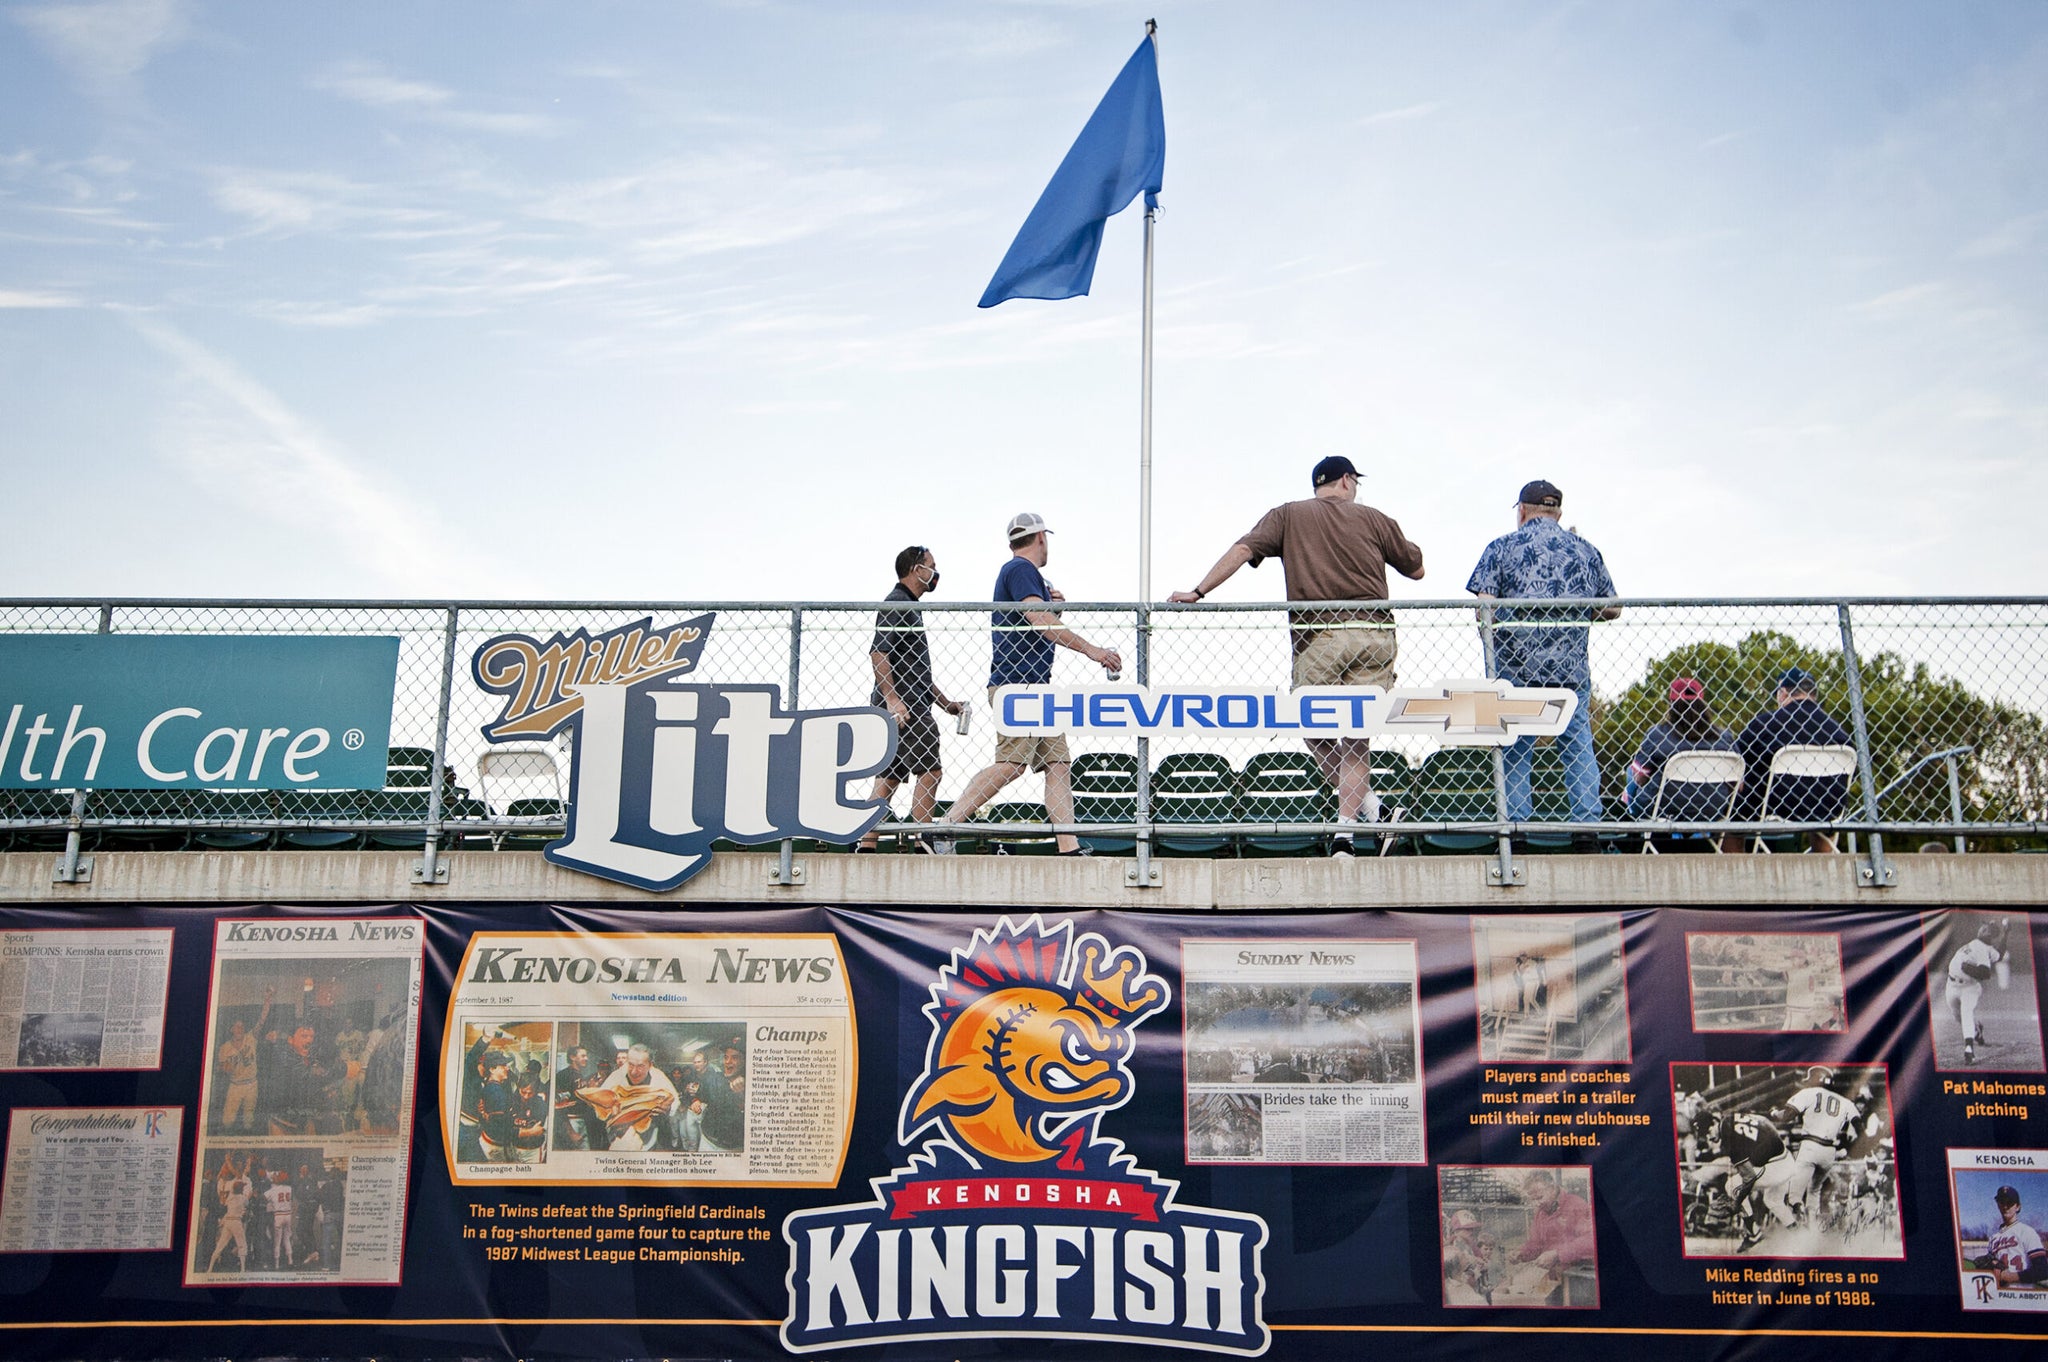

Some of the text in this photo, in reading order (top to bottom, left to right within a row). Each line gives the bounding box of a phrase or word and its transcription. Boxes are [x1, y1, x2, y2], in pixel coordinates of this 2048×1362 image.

[478, 626, 700, 720] Miller
[1002, 693, 1377, 729] CHEVROLET
[552, 682, 894, 883] Lite
[4, 933, 34, 943] Sports
[225, 921, 416, 942] KENOSHA NEWS
[2, 946, 164, 956] CHAMPIONS: Kenosha earns crown
[1237, 951, 1355, 966] SUNDAY NEWS
[468, 947, 835, 984] KENOSHA NEWS
[499, 996, 514, 1004] 1987
[611, 993, 687, 1002] Newsstand edition
[755, 1026, 828, 1045] Champs
[1485, 1069, 1631, 1085] Players and coaches
[1943, 1080, 2046, 1096] Pat Mahomes
[1264, 1092, 1409, 1109] Brides take the inning
[1482, 1090, 1636, 1104] must meet in a trailer
[1815, 1092, 1841, 1118] 10
[1470, 1111, 1651, 1125] until their new clubhouse
[1966, 1102, 2028, 1120] pitching
[80, 1136, 100, 1144] proud
[1521, 1132, 1601, 1146] is finished.
[352, 1155, 397, 1164] Championship
[648, 1158, 681, 1166] Manager
[1976, 1155, 2035, 1166] KENOSHA
[469, 1165, 532, 1174] Champagne bath
[926, 1184, 1122, 1206] KENOSHA
[469, 1204, 766, 1221] The Twins defeat the Springfield Cardinals
[463, 1225, 771, 1244] in a fog-shortened game four to capture the
[485, 1247, 745, 1265] 1987 Midwest League Championship.
[804, 1222, 1246, 1335] KINGFISH
[1705, 1268, 1879, 1286] Mike Redding fires a no
[1712, 1290, 1876, 1306] hitter in June of 1988.
[2019, 1292, 2047, 1300] ABBOTT
